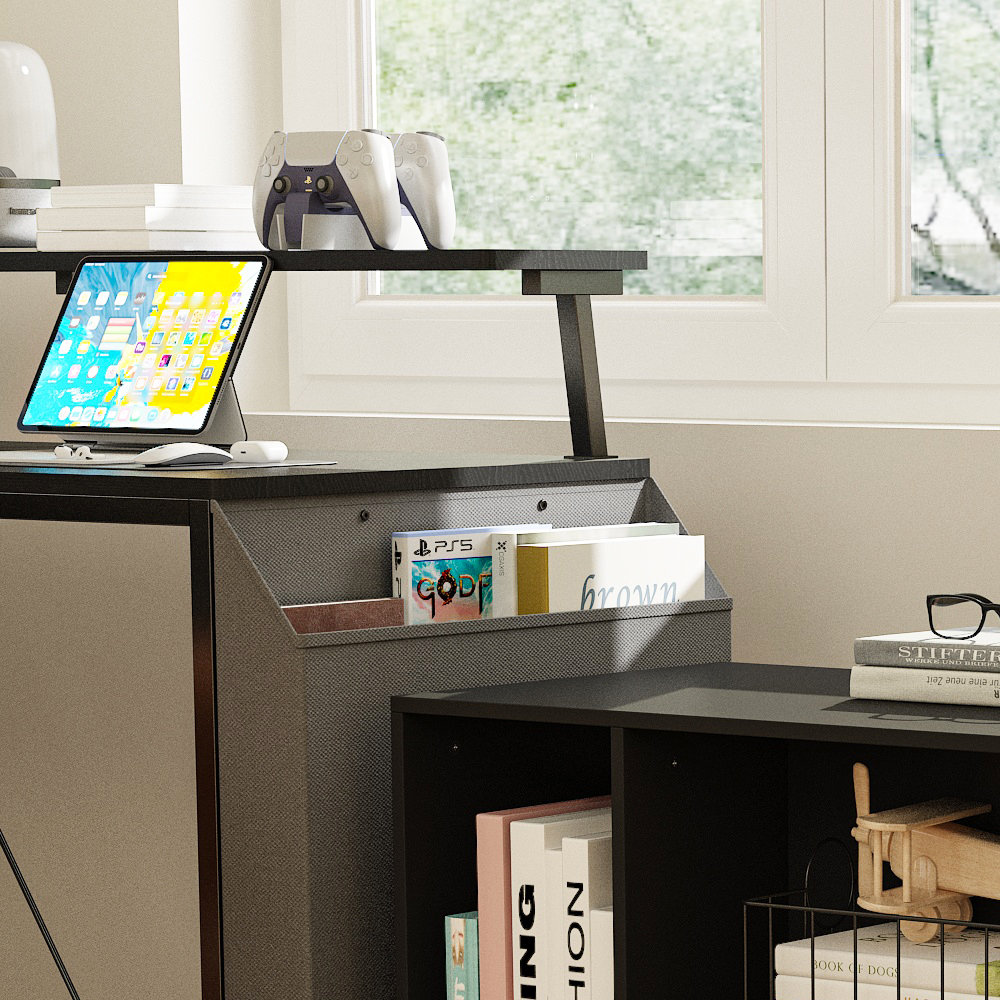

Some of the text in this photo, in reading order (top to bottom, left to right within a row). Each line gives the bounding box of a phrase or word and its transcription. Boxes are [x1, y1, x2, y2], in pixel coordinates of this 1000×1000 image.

[434, 539, 473, 552] PS5
[905, 657, 940, 665] WERKE
[926, 675, 943, 686] Zeit
[945, 676, 967, 685] neue
[968, 678, 988, 687] eine
